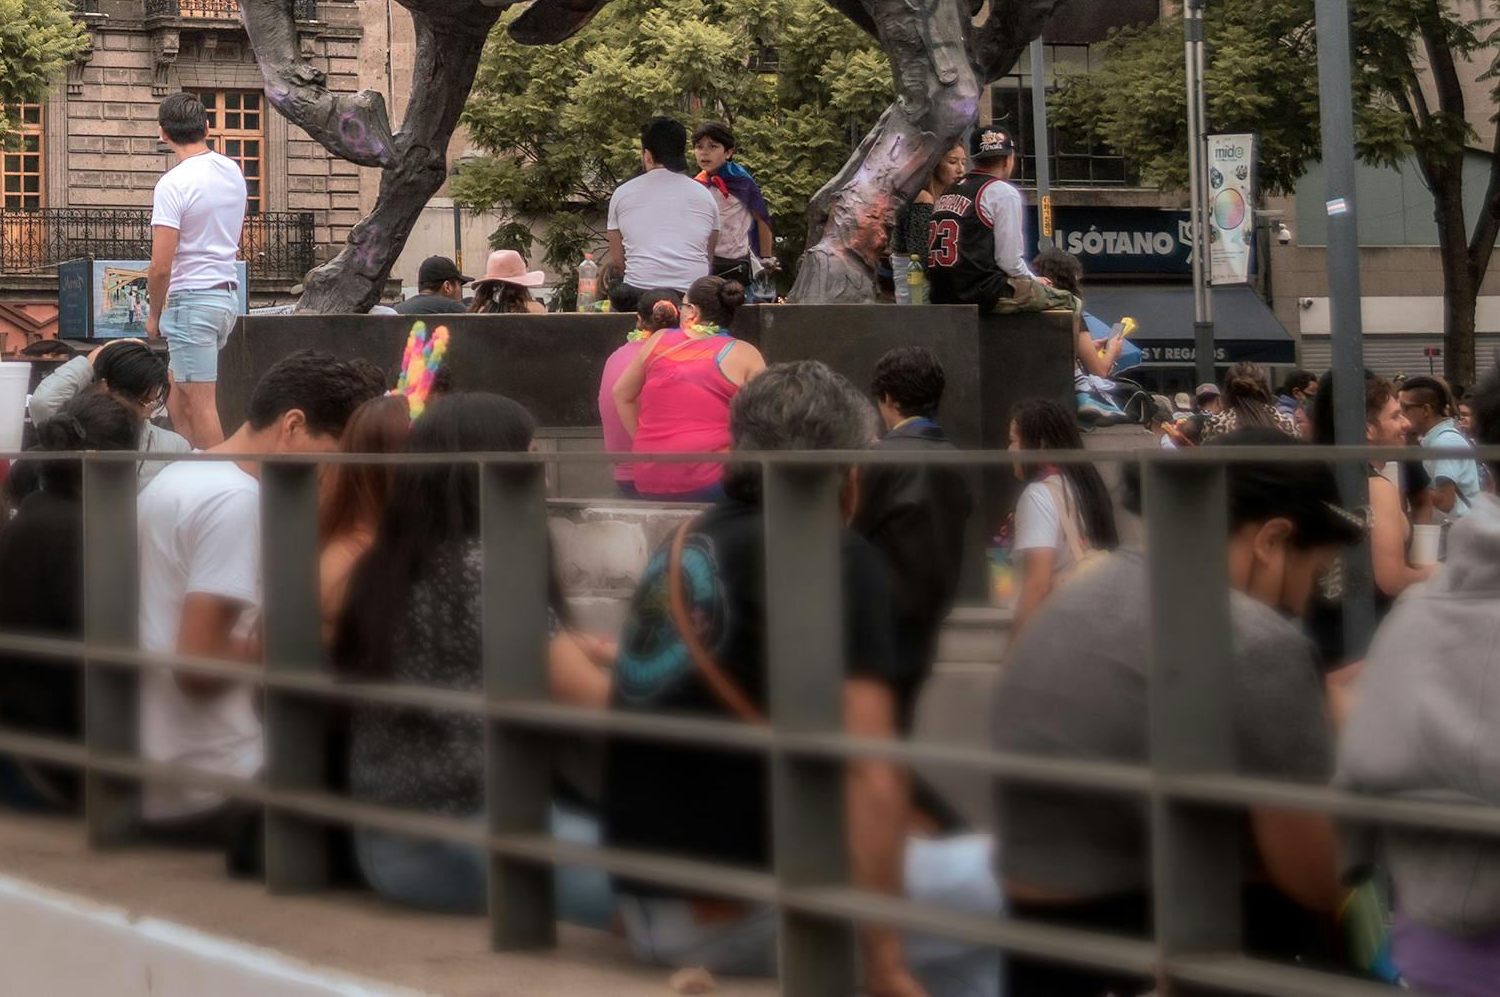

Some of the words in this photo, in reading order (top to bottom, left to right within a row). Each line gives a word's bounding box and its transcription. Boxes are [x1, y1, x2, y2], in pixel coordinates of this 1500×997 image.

[927, 219, 960, 267] 23
[1067, 225, 1174, 255] SÓTANO
[1152, 348, 1162, 360] Y
[1165, 348, 1225, 360] REGAS
